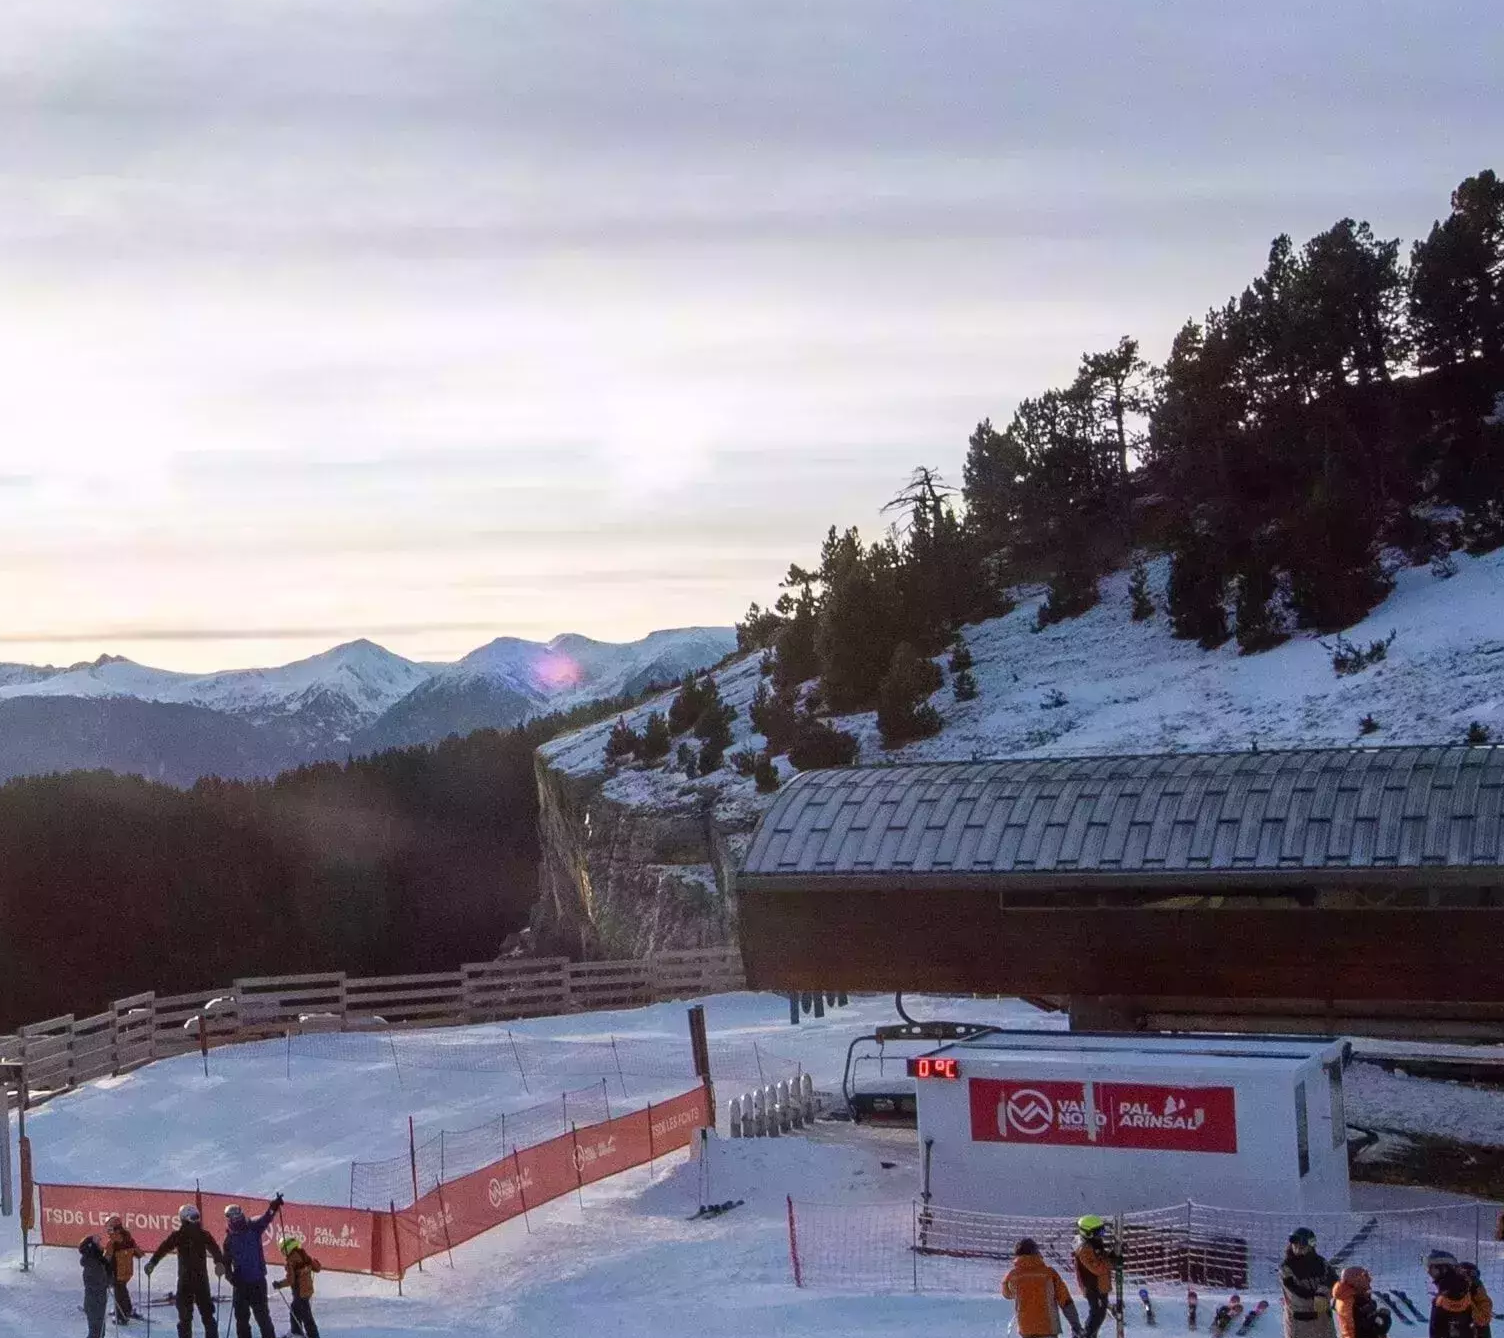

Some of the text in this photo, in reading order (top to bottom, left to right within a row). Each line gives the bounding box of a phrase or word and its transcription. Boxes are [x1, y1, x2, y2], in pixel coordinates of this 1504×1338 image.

[918, 1059, 930, 1078] 0
[1119, 1101, 1153, 1116] PAL
[1119, 1114, 1198, 1131] ARINSAL
[43, 1207, 182, 1231] TSD6 LE FONTS
[314, 1226, 334, 1238] PAL
[313, 1236, 360, 1248] ARINSAL
